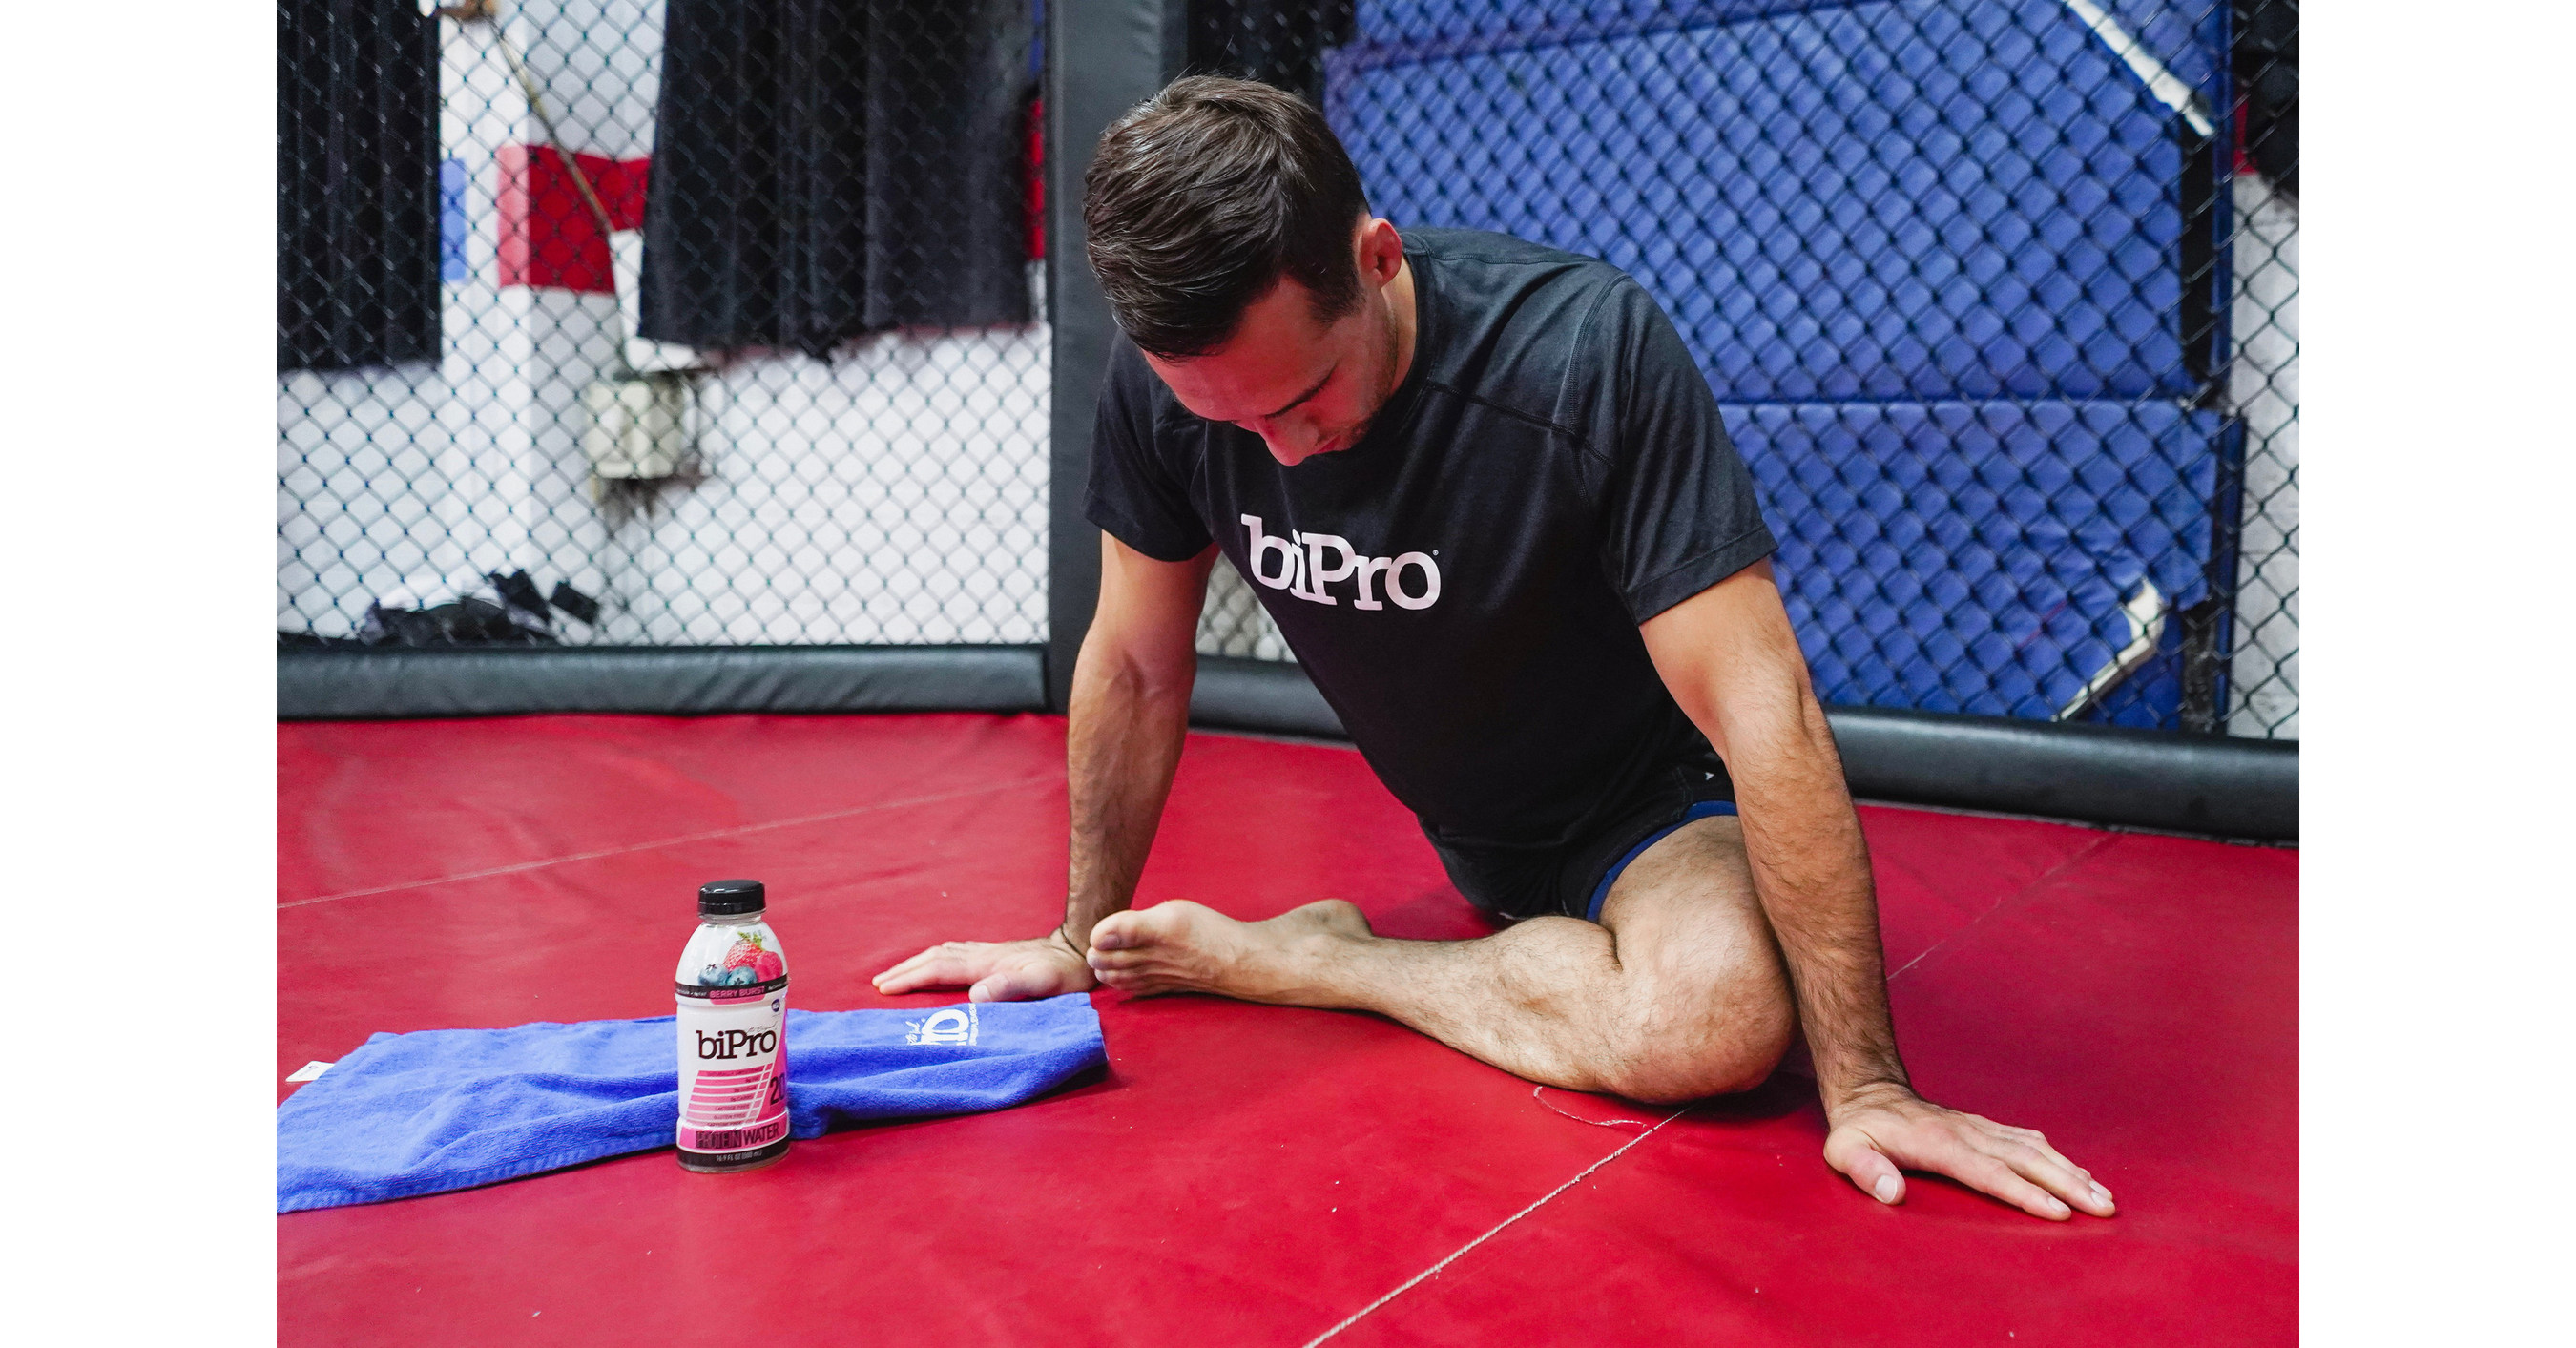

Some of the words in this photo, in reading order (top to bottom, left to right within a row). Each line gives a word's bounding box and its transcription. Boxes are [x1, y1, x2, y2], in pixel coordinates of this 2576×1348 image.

[1241, 513, 1442, 611] biPro
[710, 989, 738, 999] BERRY
[739, 985, 766, 996] BURST
[696, 1029, 777, 1059] biPro
[743, 1122, 779, 1145] WATER
